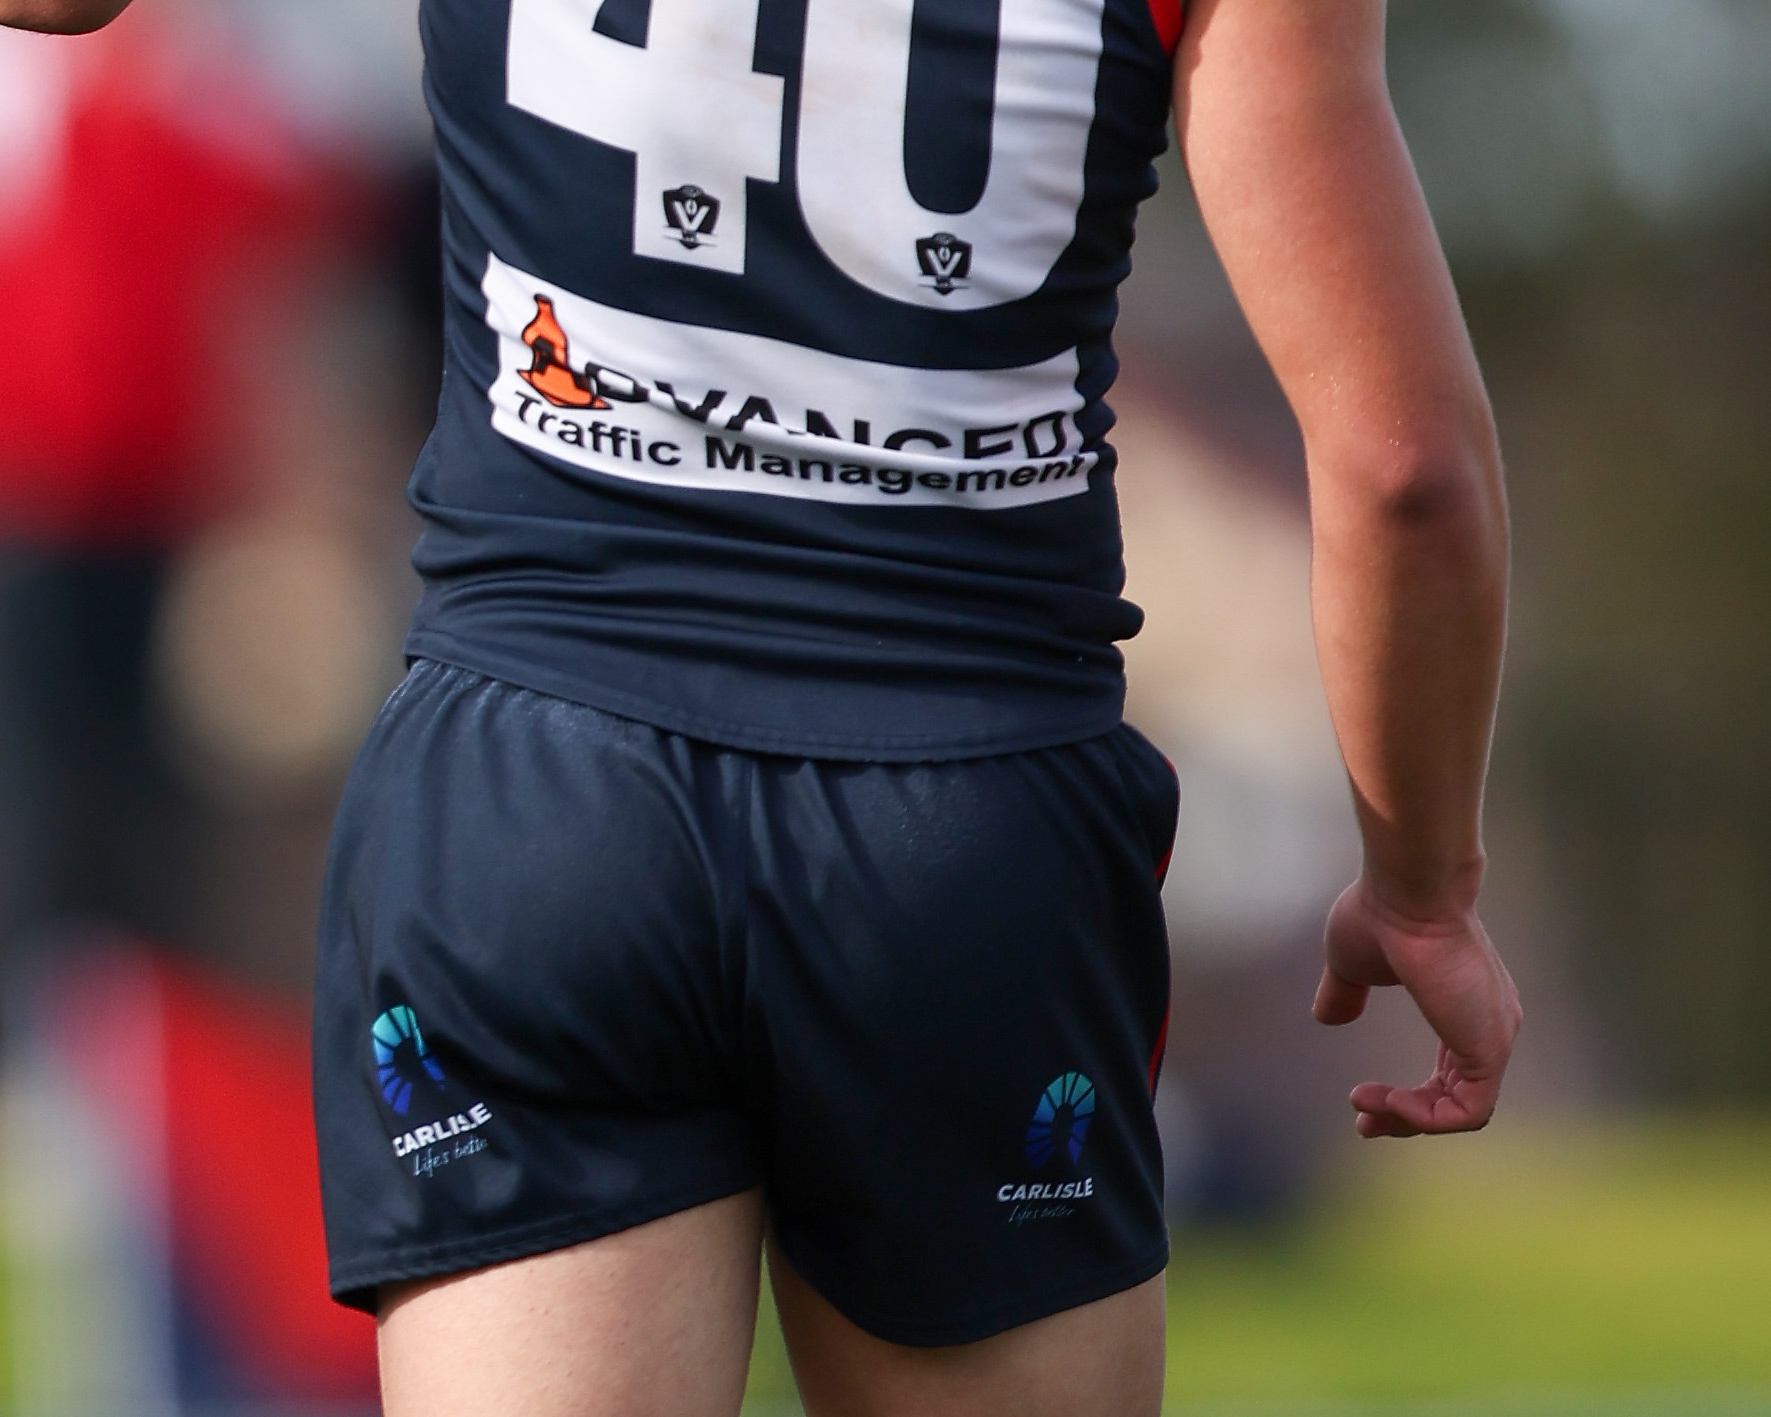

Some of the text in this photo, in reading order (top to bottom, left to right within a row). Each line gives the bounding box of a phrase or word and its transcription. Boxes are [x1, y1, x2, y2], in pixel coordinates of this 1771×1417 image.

[515, 391, 1085, 495] Traffic Management
[997, 1177, 1093, 1202] CARLISLE
